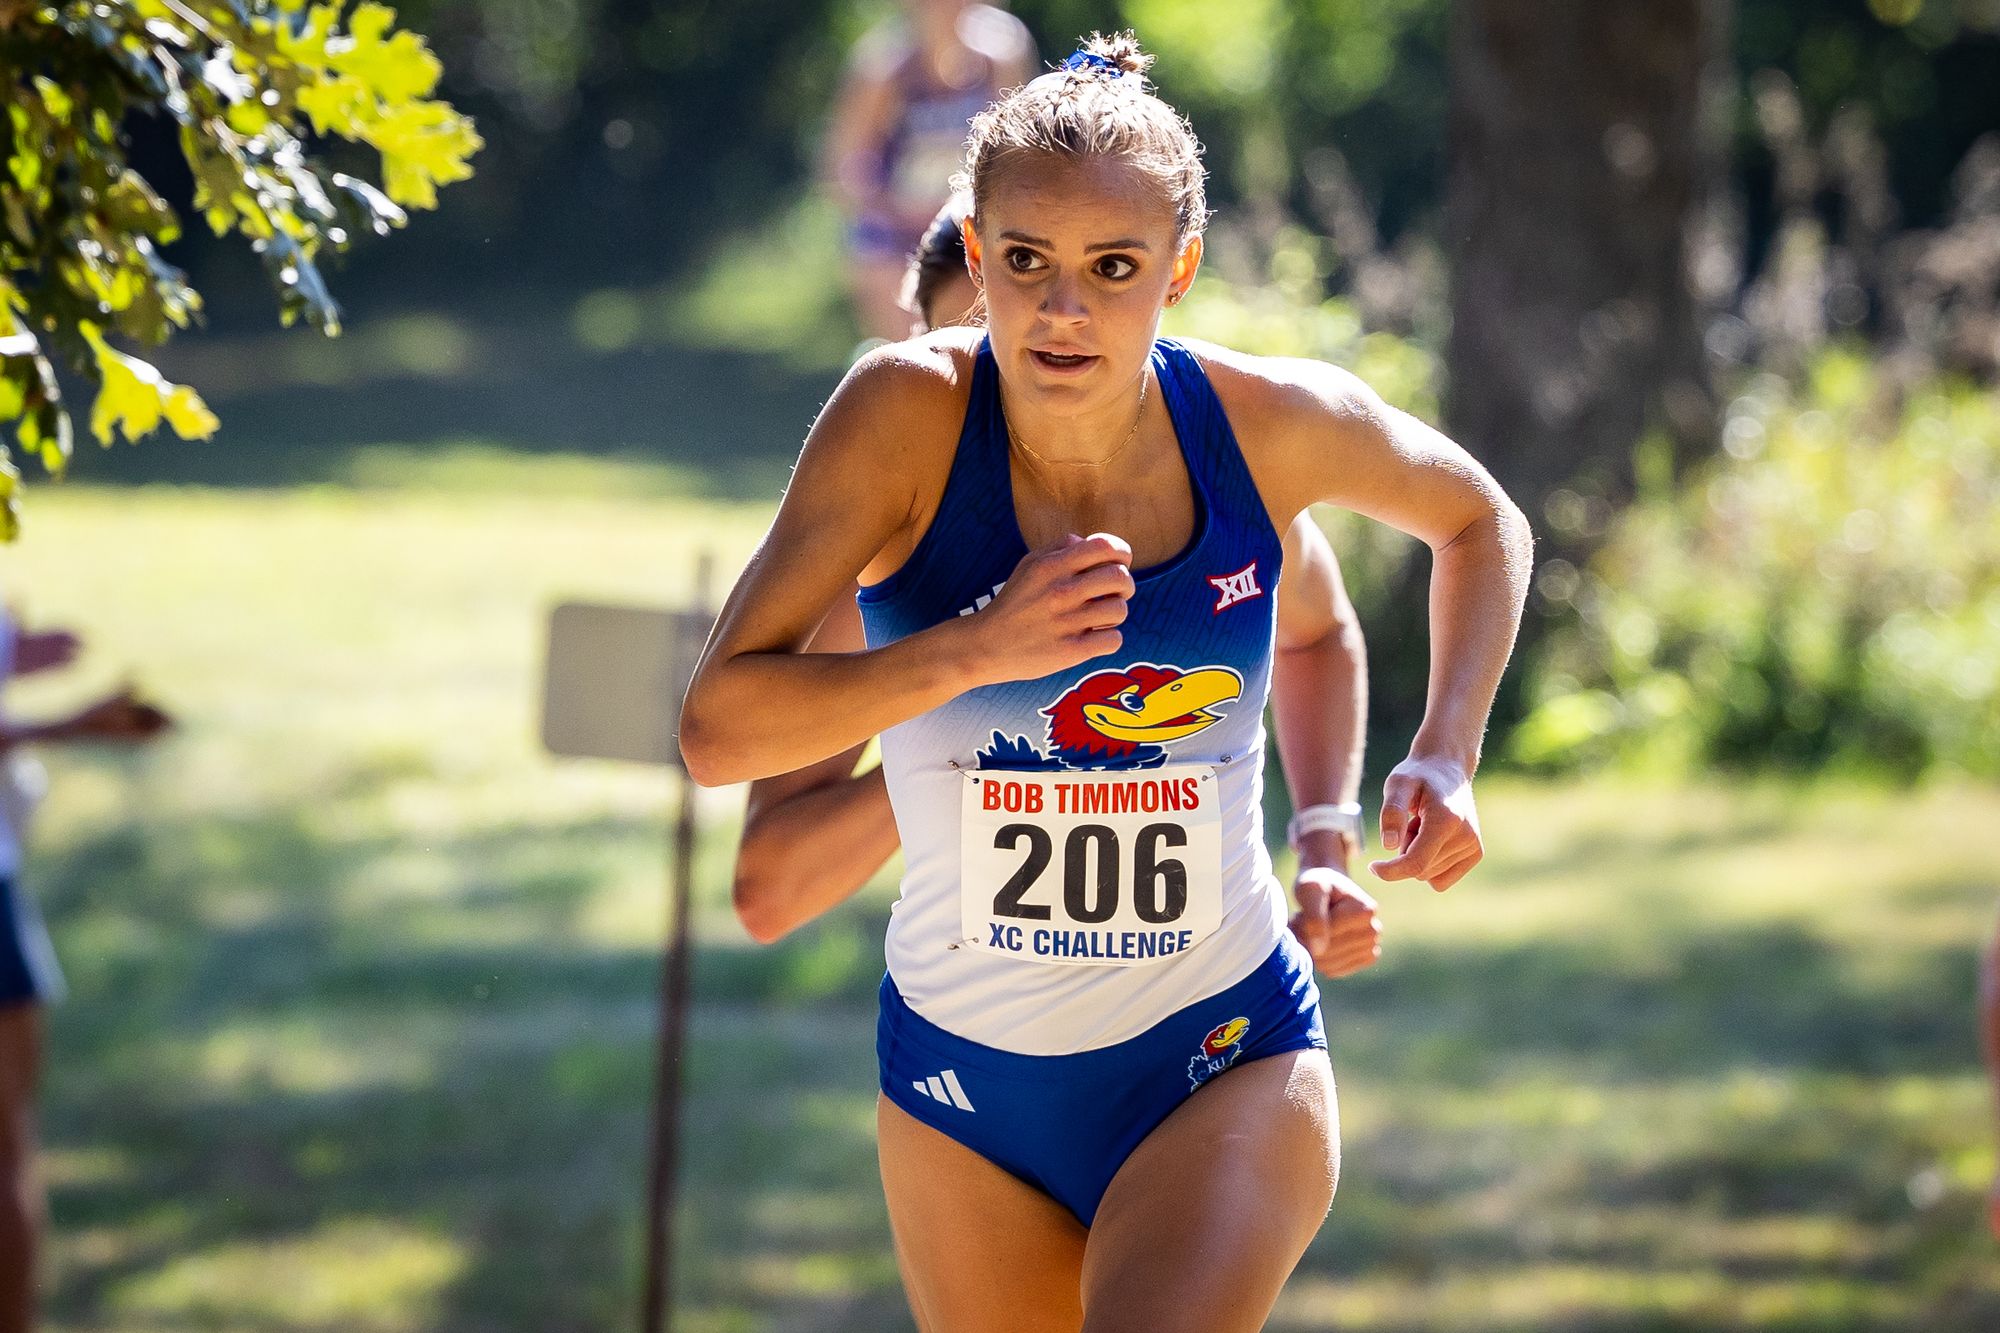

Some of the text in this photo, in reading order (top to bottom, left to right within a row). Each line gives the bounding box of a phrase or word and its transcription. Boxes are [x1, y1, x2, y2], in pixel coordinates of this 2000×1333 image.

[1210, 562, 1262, 611] XII
[982, 777, 1200, 815] BOB TIMMONS
[993, 822, 1188, 924] 206
[988, 922, 1193, 960] XC CHALLENGE
[1207, 1056, 1226, 1074] KU
